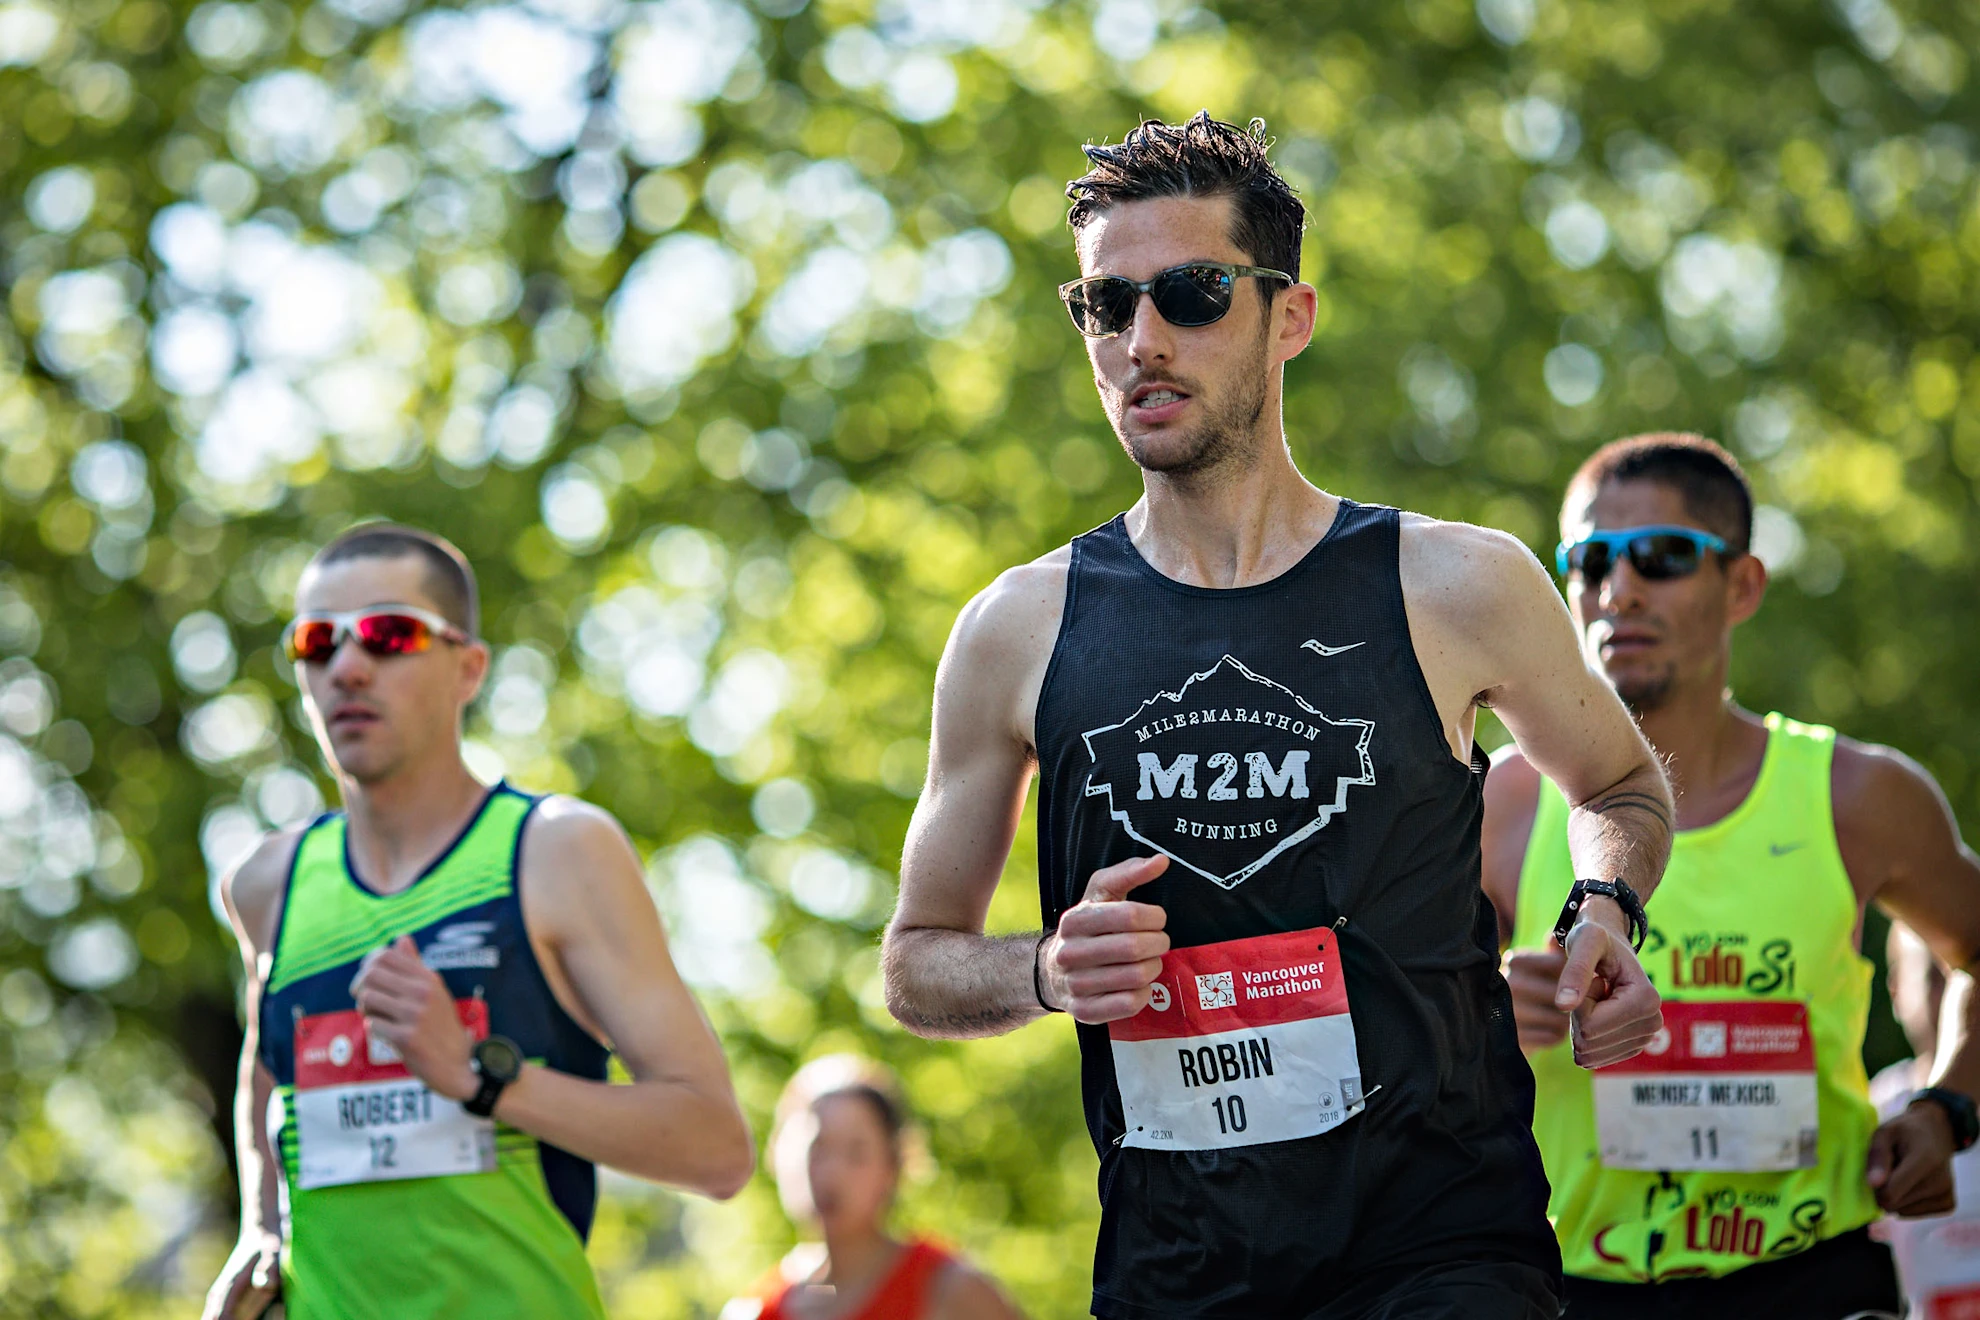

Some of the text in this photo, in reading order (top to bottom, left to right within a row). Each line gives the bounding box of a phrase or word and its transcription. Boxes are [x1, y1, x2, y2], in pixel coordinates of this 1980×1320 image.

[1135, 708, 1320, 743] MILE2MARATHON
[1136, 750, 1311, 801] M2M
[1174, 817, 1278, 840] RUNNING
[1242, 961, 1326, 985] Vancouver
[1245, 977, 1323, 1001] Marathon
[1177, 1037, 1275, 1088] ROBIN
[338, 1088, 433, 1130] ROBERT
[1633, 1080, 1702, 1106] MENDEZ
[1211, 1095, 1248, 1134] 10
[1319, 1111, 1339, 1123] 2018
[1150, 1129, 1174, 1140] 42.2KM
[1690, 1127, 1718, 1159] 11
[369, 1136, 398, 1169] 12
